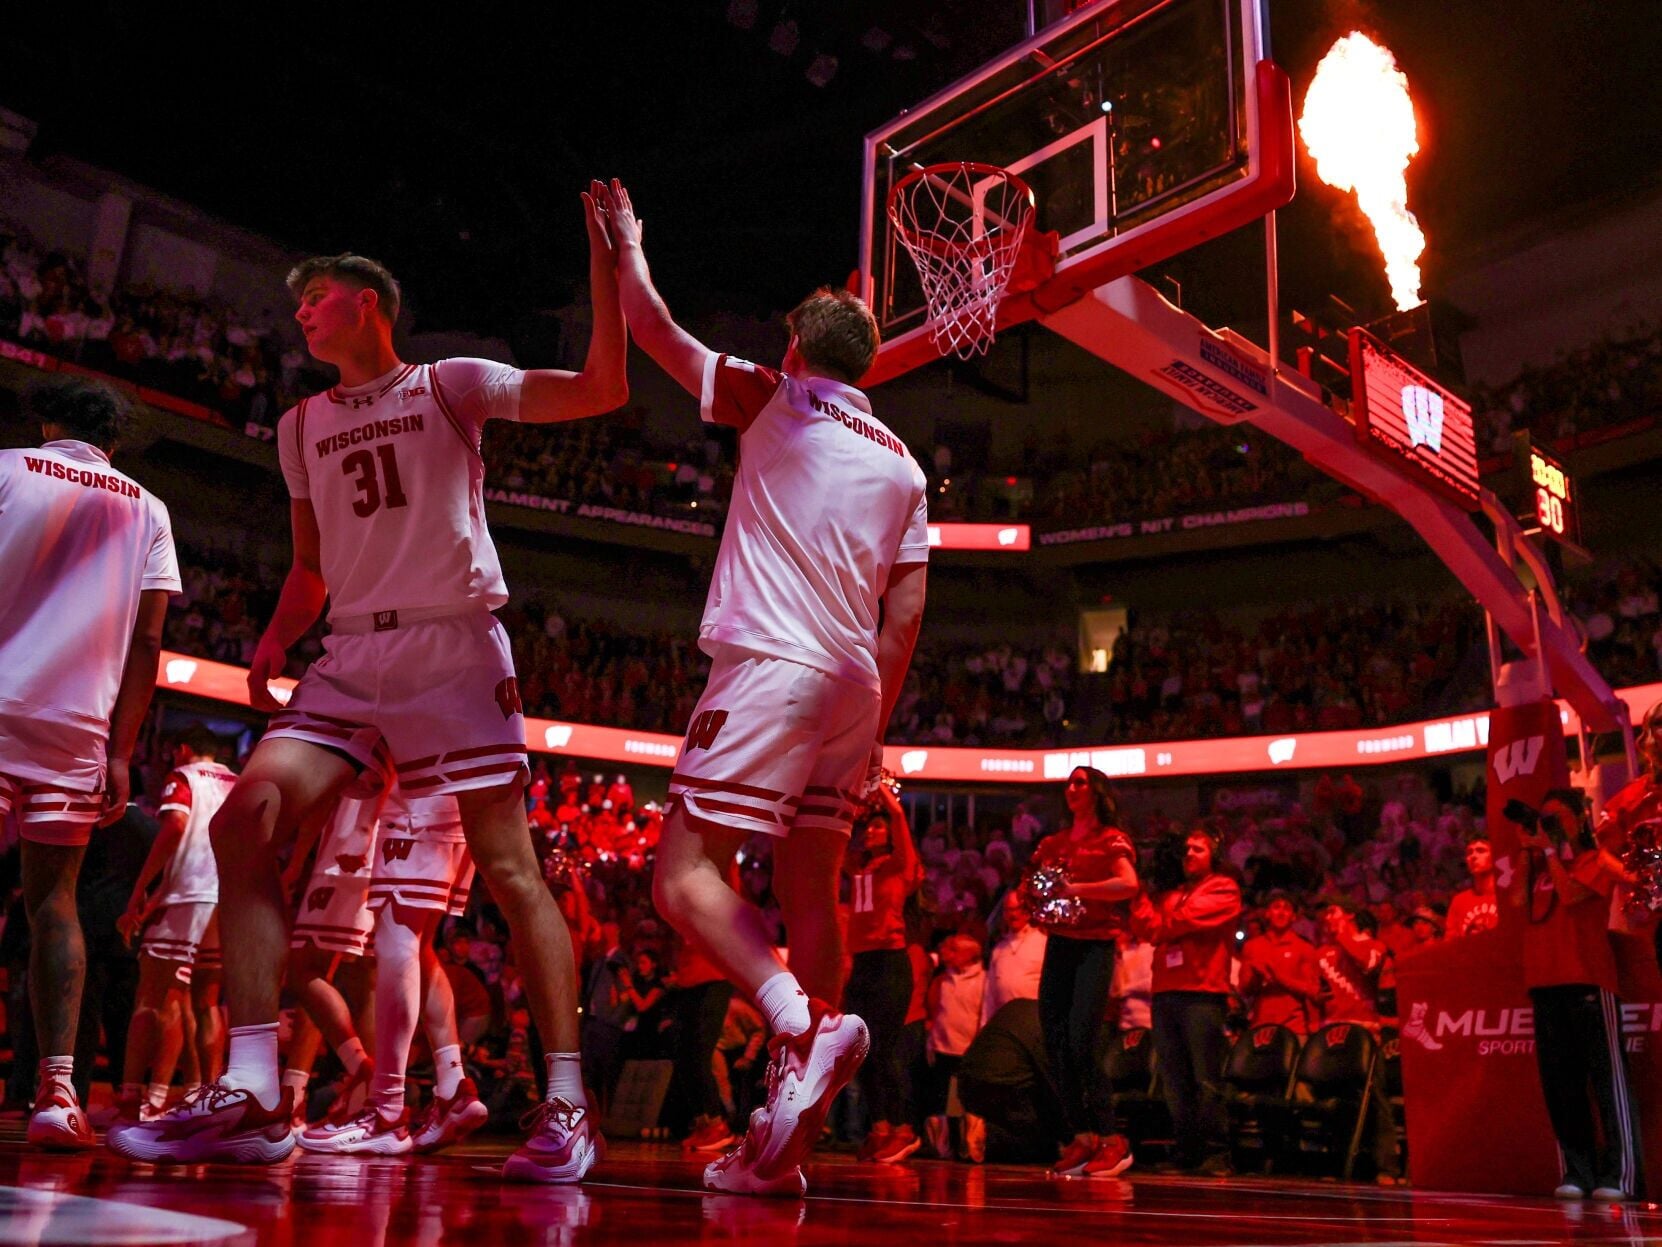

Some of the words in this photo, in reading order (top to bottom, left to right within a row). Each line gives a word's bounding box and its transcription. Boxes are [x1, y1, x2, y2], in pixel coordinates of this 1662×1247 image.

[315, 414, 424, 458] WISCONSIN
[805, 389, 904, 458] WISCONSIN
[24, 456, 141, 499] WISCONSIN
[341, 443, 408, 518] 31
[1182, 501, 1310, 529] CHAMPIONS
[1478, 1039, 1537, 1056] SPORT
